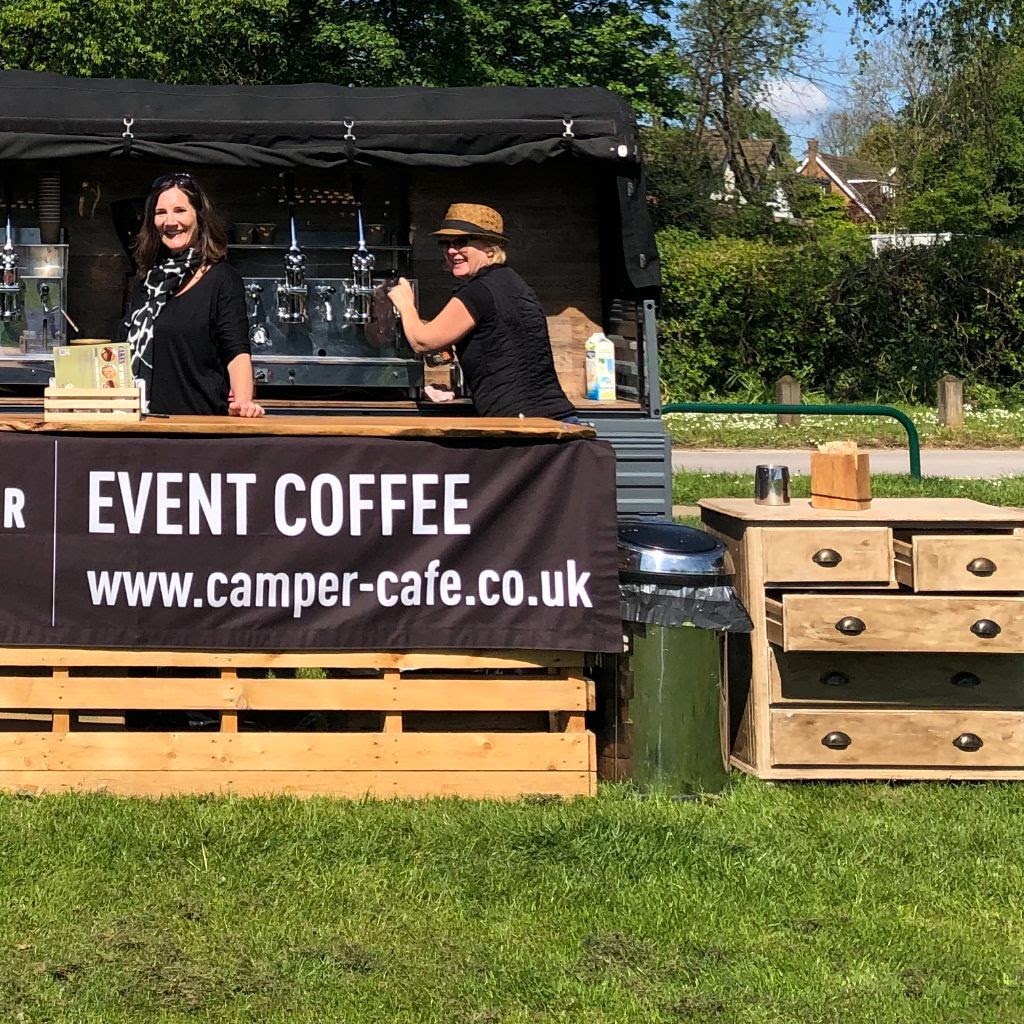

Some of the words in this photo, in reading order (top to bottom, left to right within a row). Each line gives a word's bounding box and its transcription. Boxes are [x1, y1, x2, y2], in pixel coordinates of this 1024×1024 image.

[88, 470, 257, 536] EVENT
[274, 473, 471, 537] COFFEE
[86, 559, 594, 619] www.camper-cafe.co.uk
